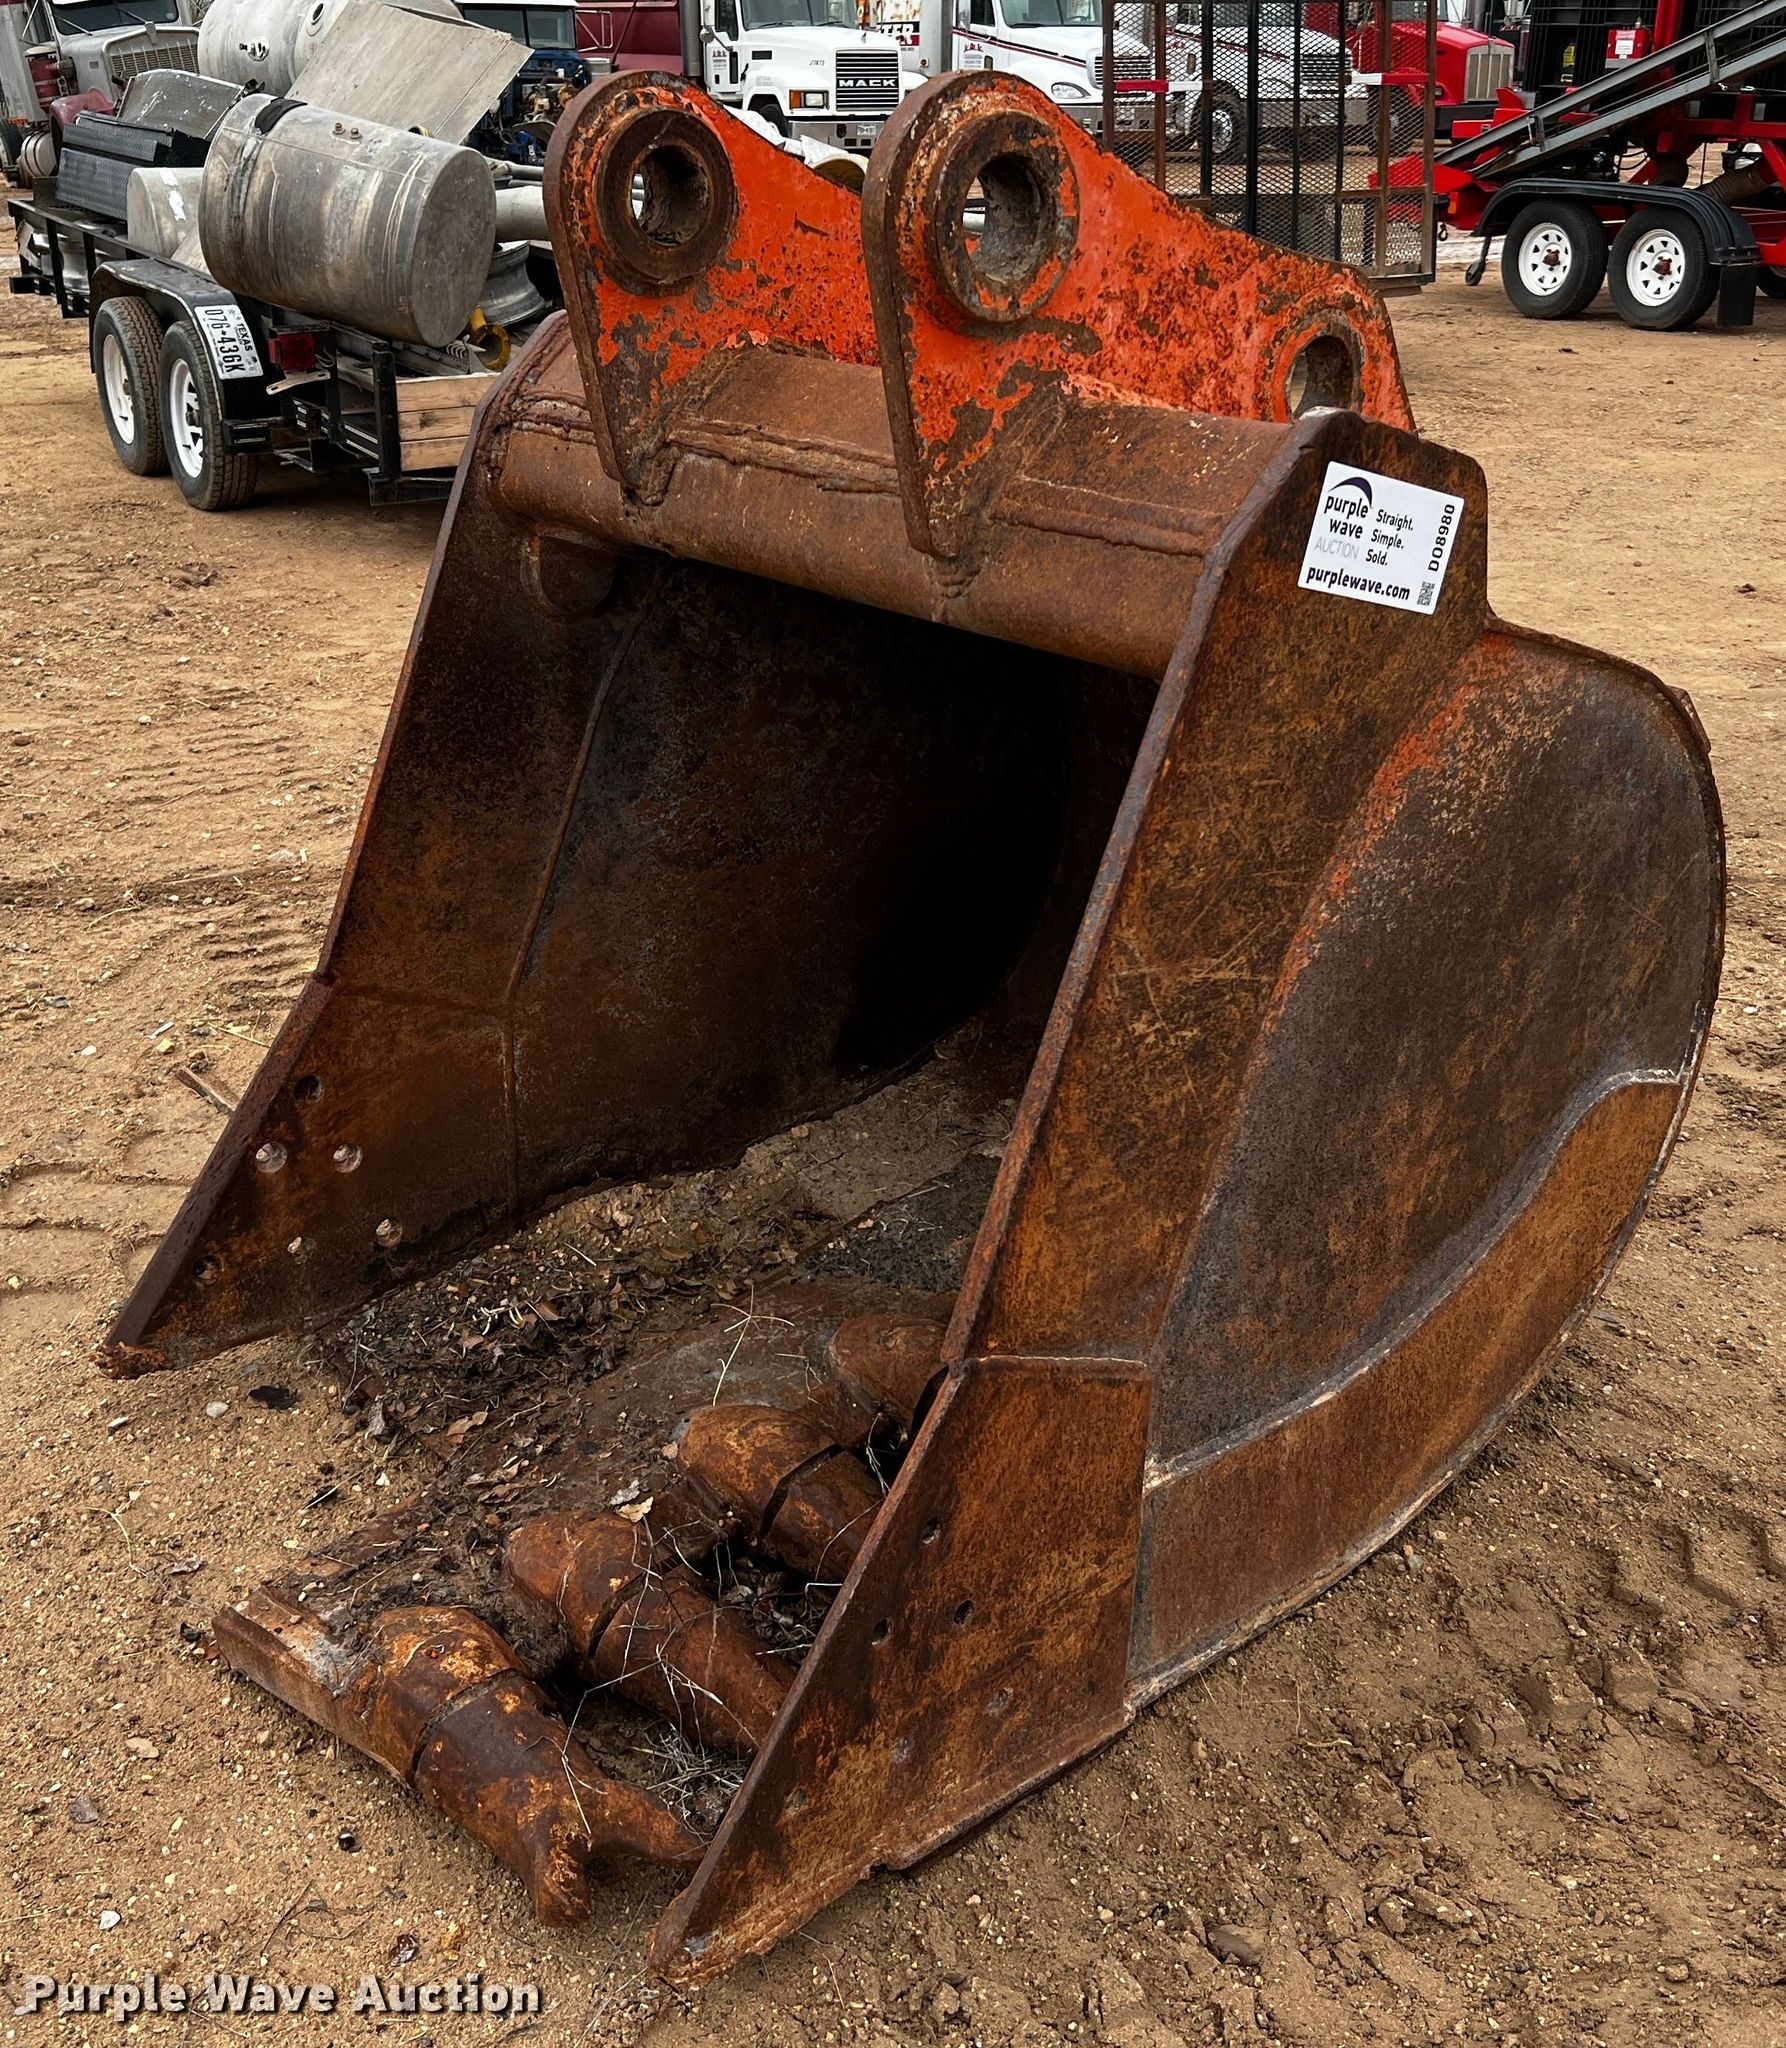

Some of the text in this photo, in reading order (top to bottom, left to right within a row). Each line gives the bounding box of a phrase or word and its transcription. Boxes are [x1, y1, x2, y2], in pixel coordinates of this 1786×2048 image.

[838, 79, 896, 87] MACK
[236, 322, 253, 352] TEXAS
[1324, 495, 1369, 519] purple
[1329, 518, 1363, 539] wave
[1375, 509, 1414, 531] Straight.
[1314, 536, 1360, 560] AUCTION
[1370, 529, 1404, 550] Simple.
[1365, 549, 1388, 566] Sold.
[1305, 566, 1410, 600] purplewave.com
